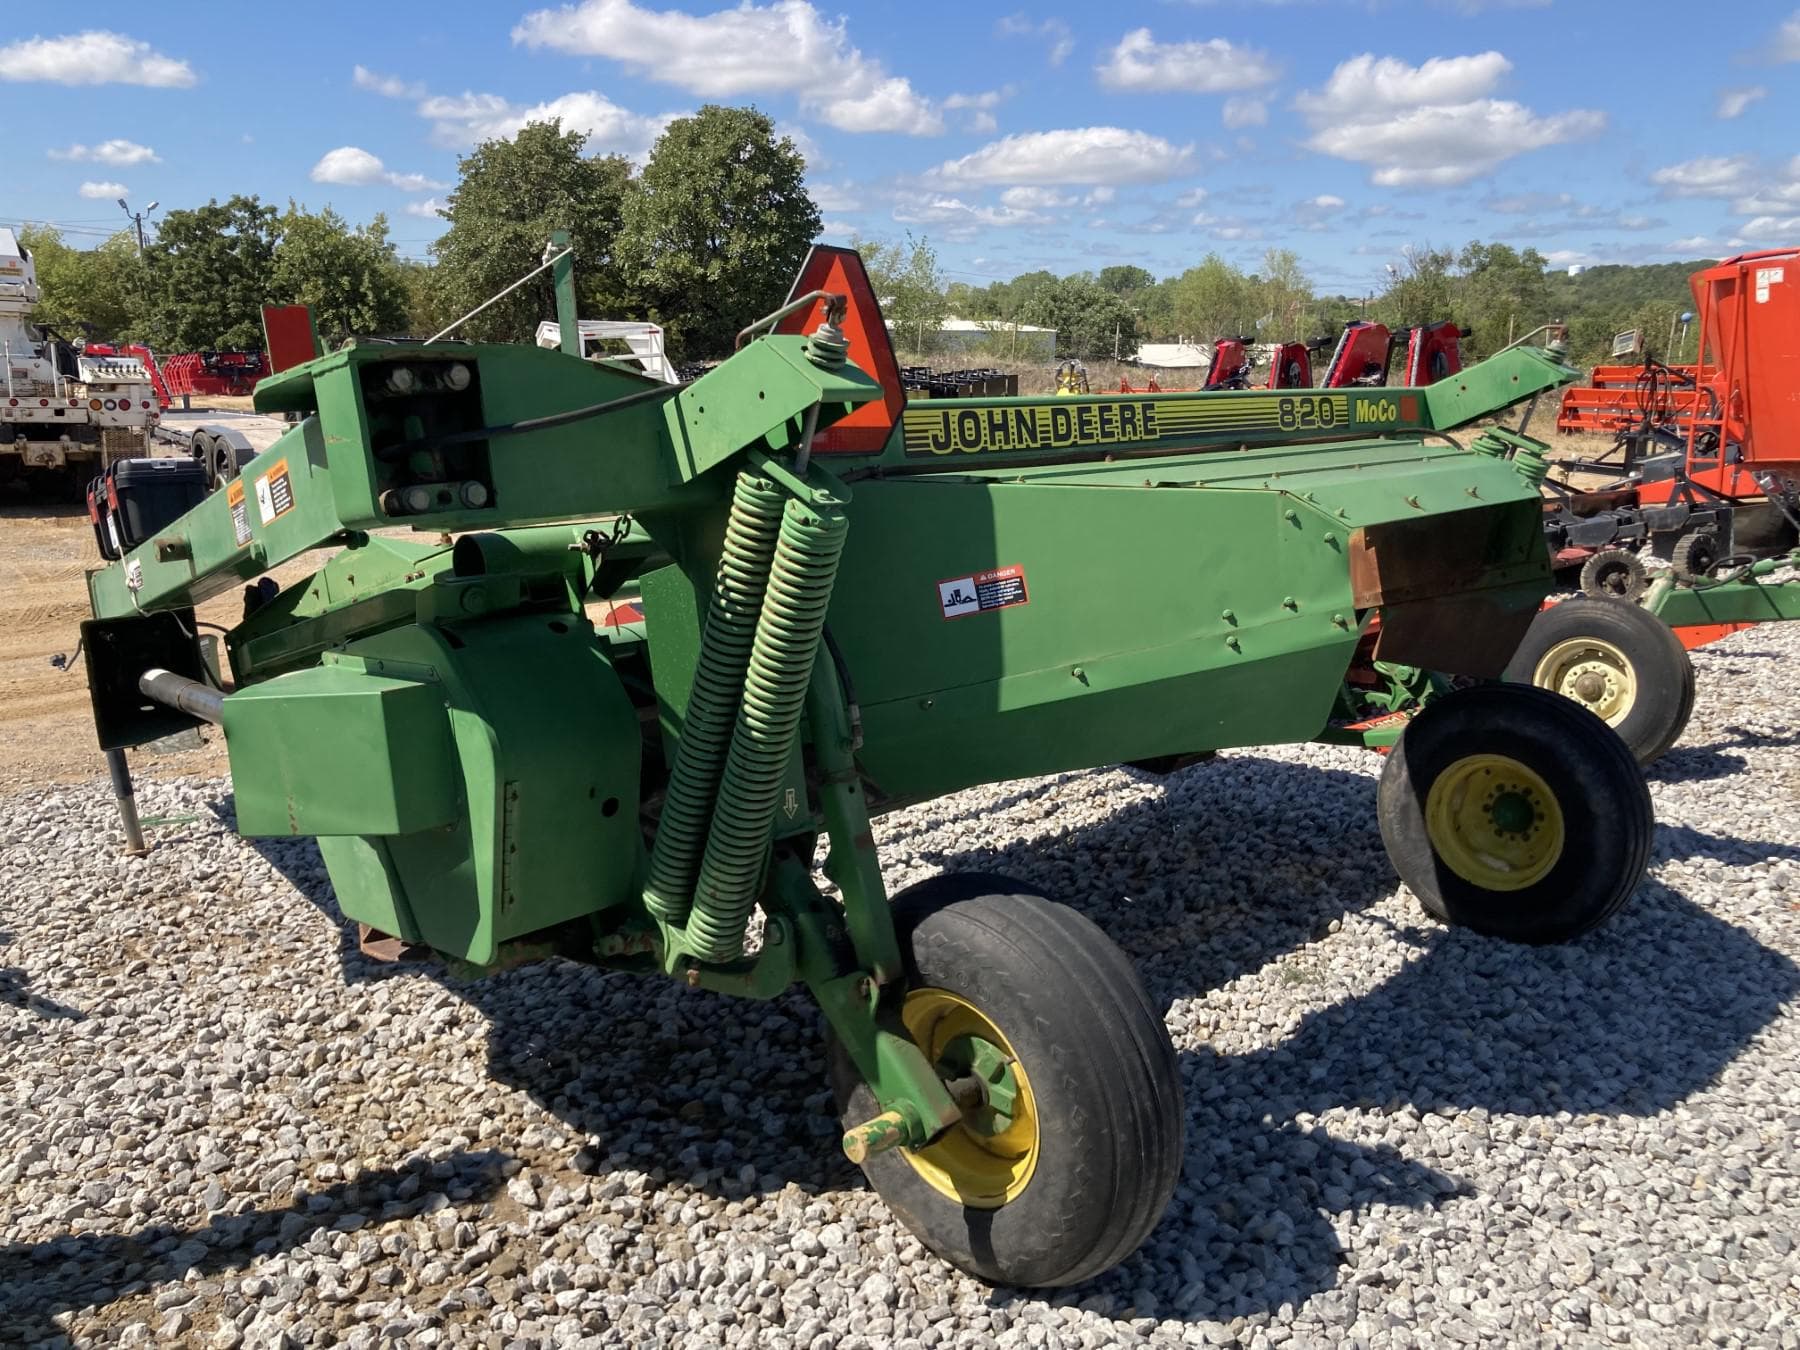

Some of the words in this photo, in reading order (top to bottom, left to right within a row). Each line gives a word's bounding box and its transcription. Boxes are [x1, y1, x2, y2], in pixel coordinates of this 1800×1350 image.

[1279, 397, 1336, 431] 820
[1356, 399, 1397, 423] MoCo
[930, 408, 1039, 453] JOHN
[1050, 402, 1160, 446] DEERE
[987, 568, 1016, 580] DANGER
